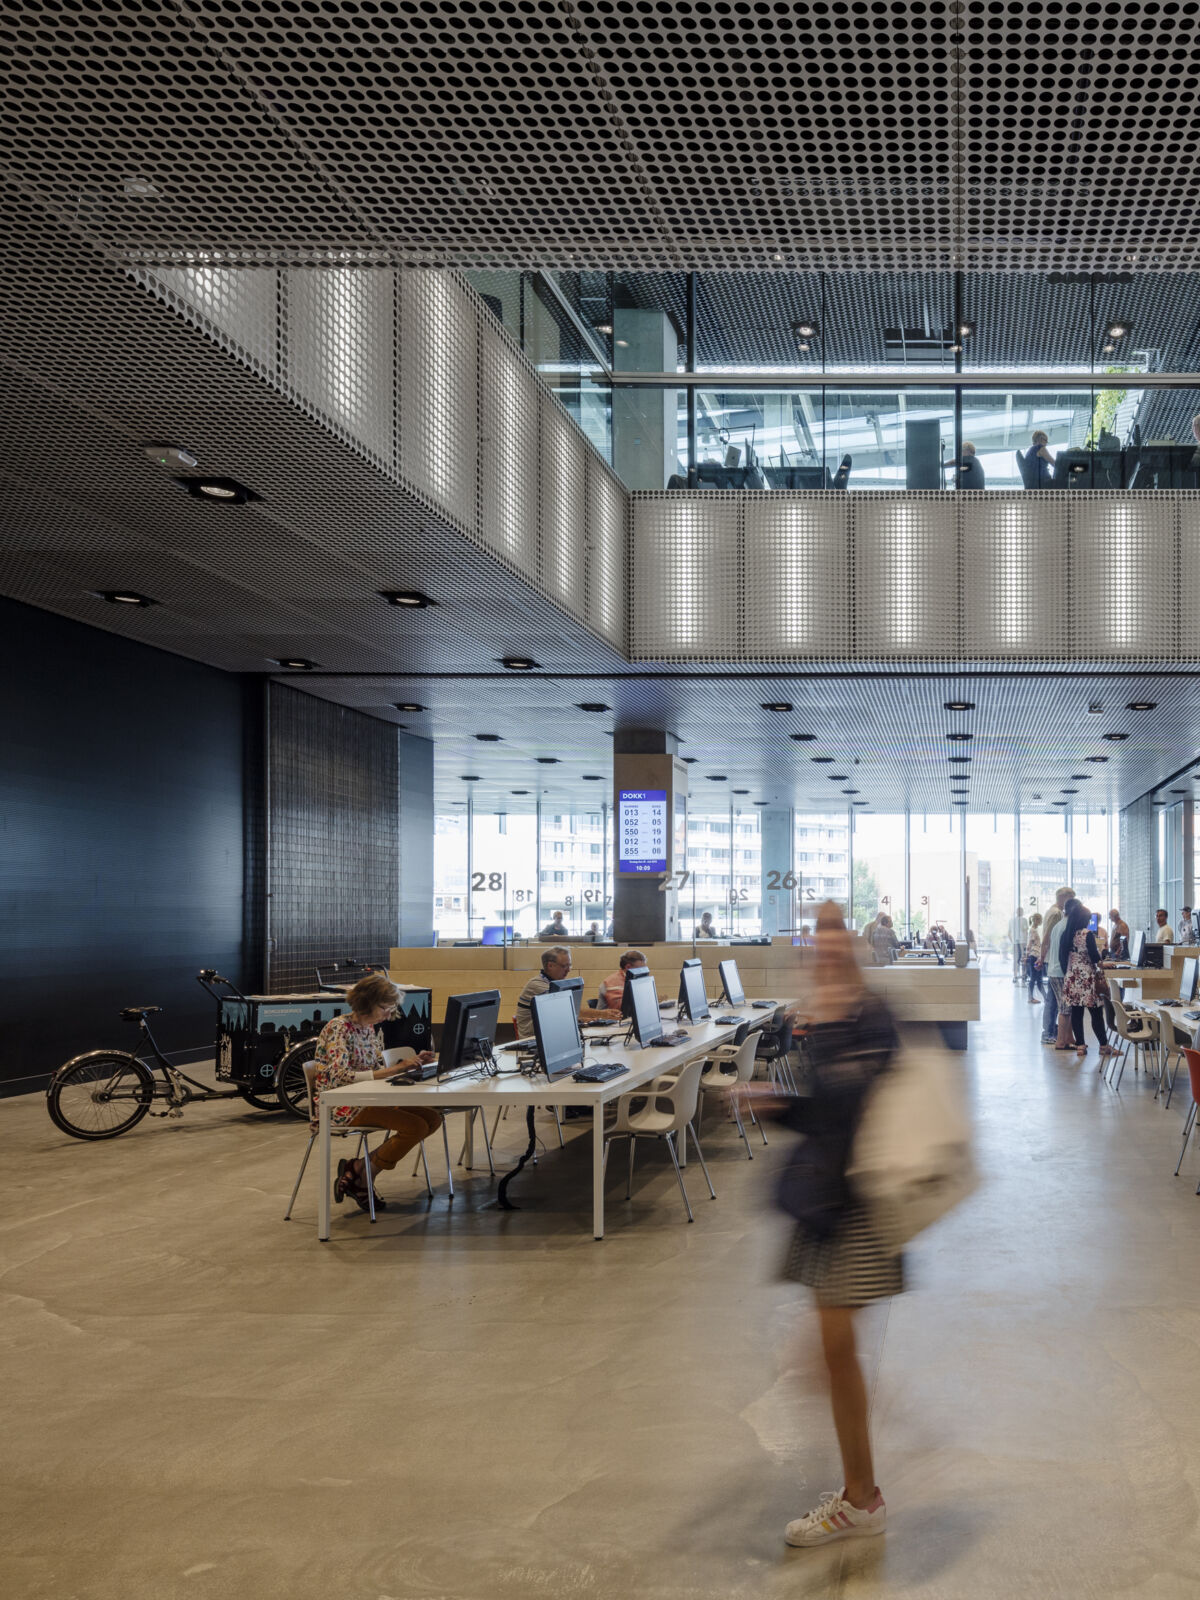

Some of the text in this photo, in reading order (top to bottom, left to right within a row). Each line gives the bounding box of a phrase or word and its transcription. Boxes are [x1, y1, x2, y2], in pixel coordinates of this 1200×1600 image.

[624, 818, 662, 826] 052 05
[624, 828, 639, 836] 550
[624, 847, 639, 855] 855
[471, 872, 503, 892] 28
[658, 870, 690, 891] 27
[766, 870, 798, 891] 26
[564, 896, 573, 907] 8
[881, 895, 889, 906] 4
[921, 895, 928, 906] 3
[1029, 896, 1037, 907] 2
